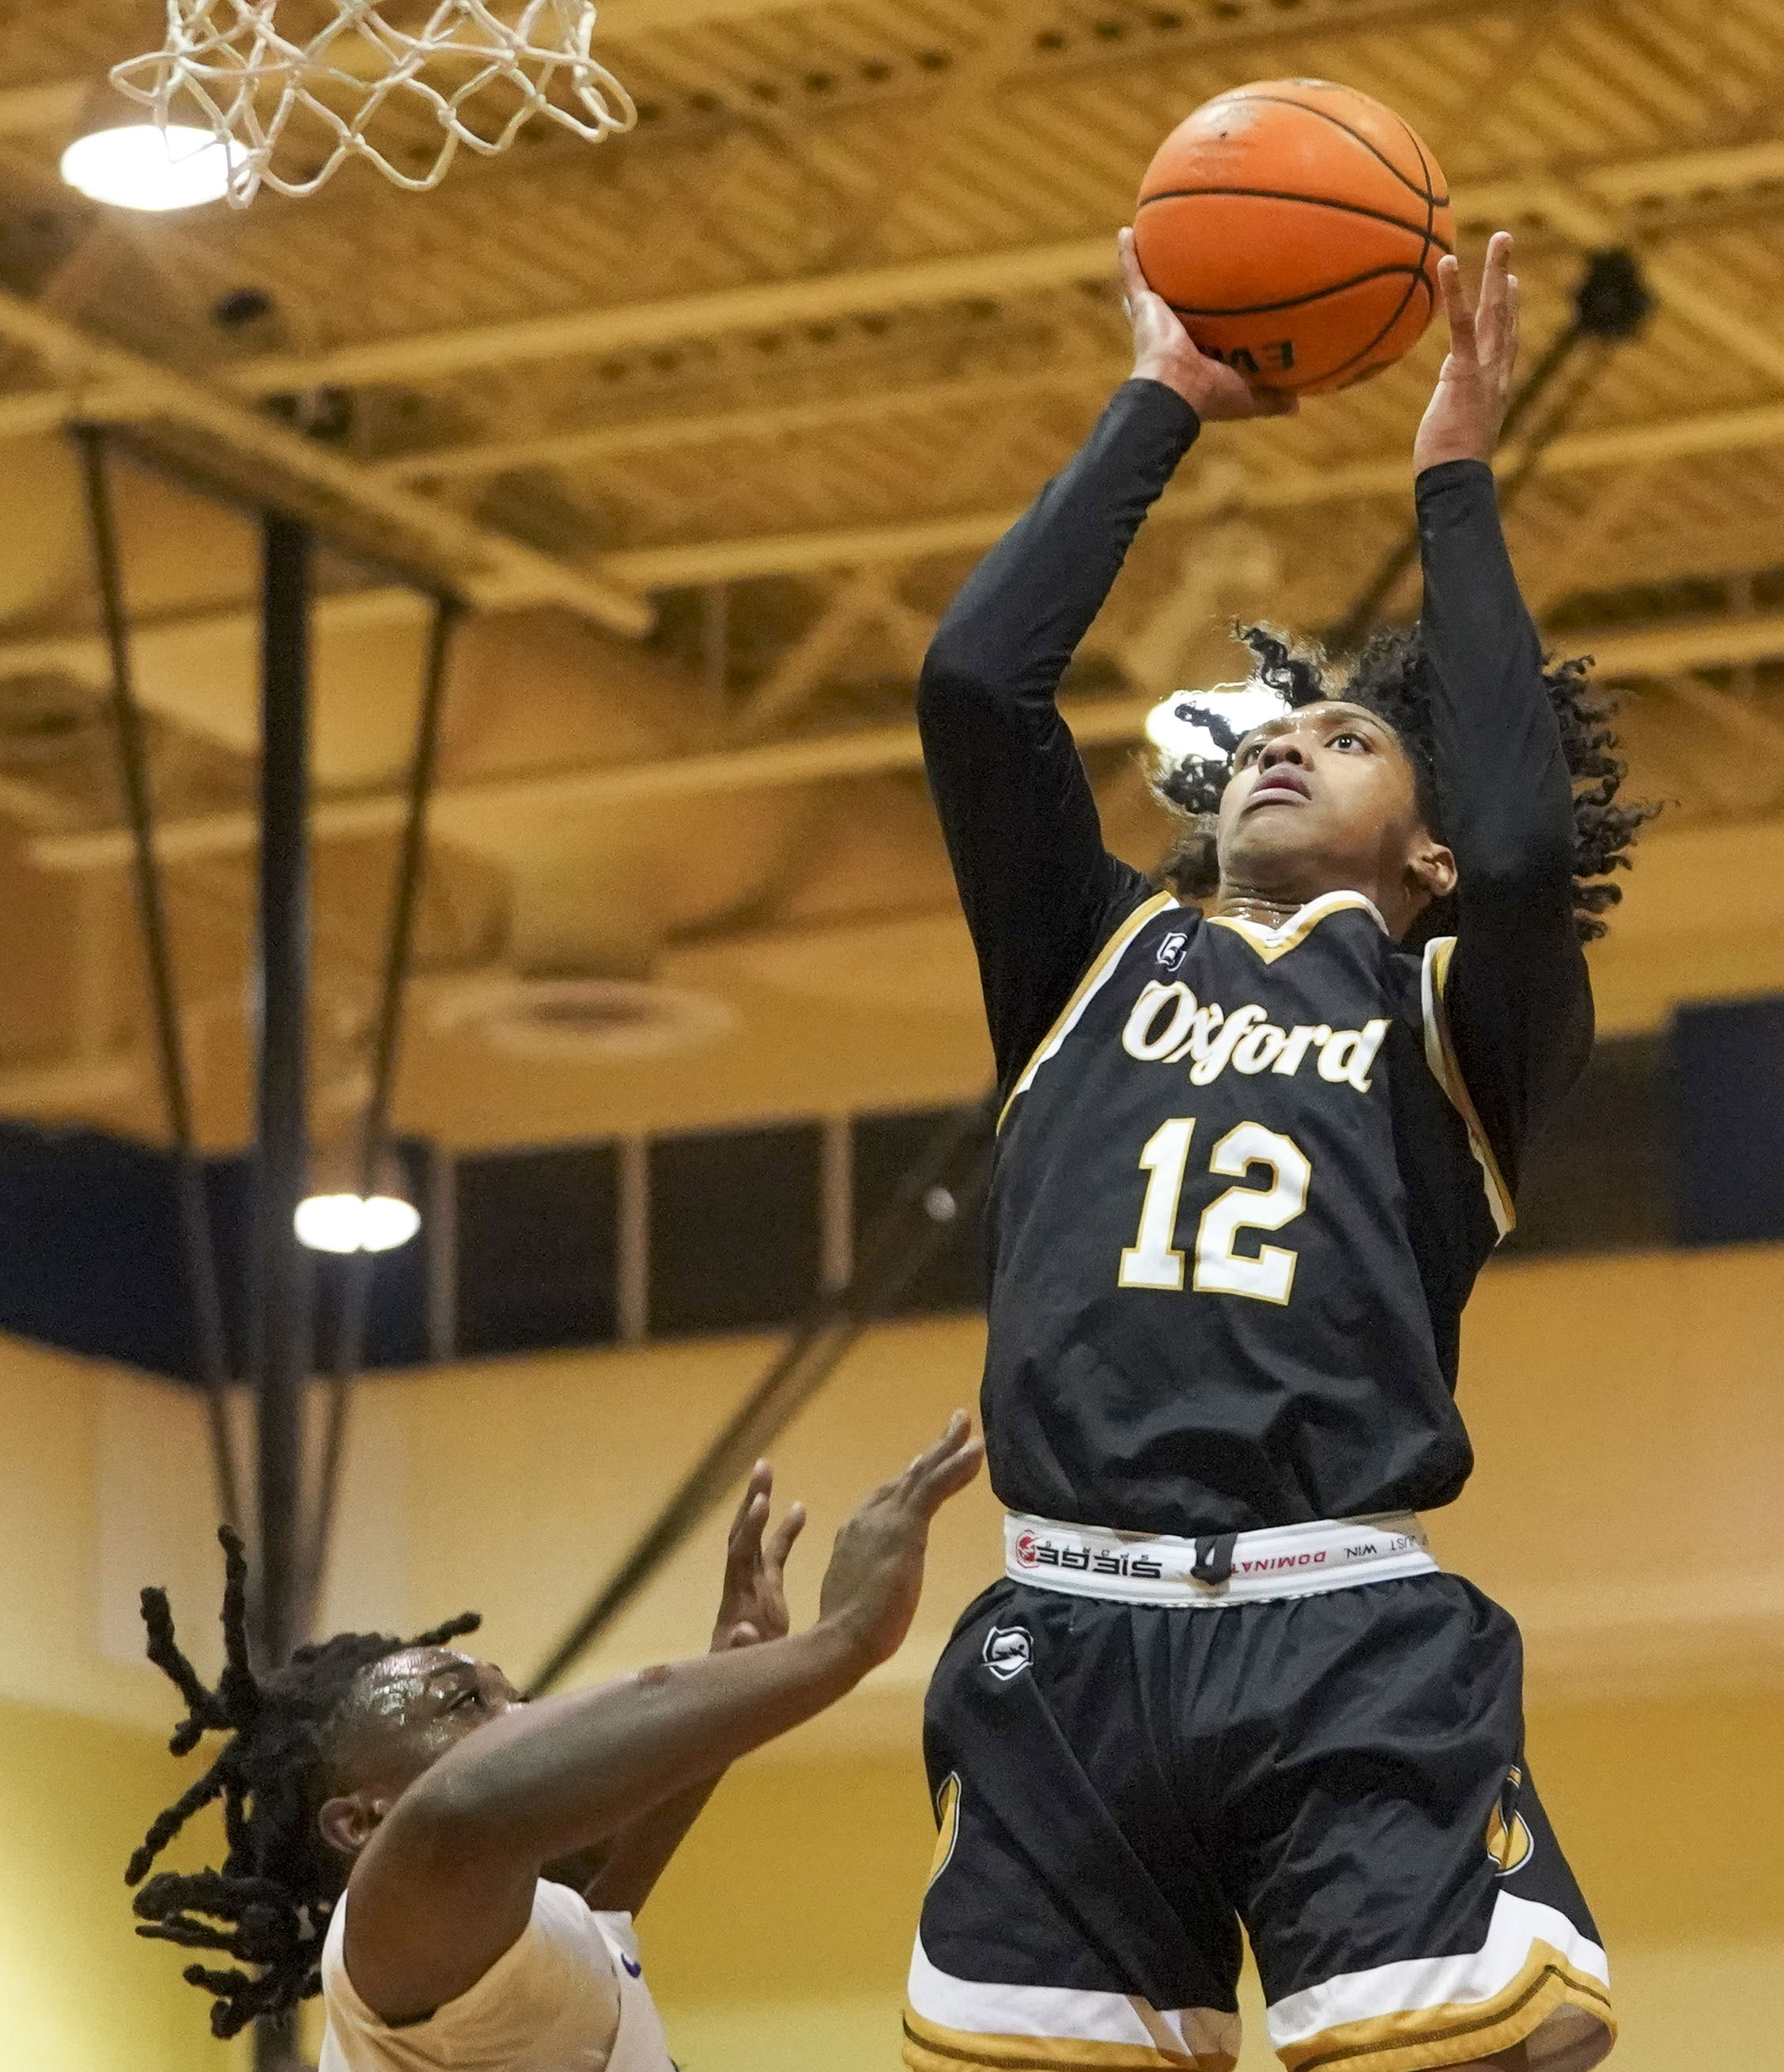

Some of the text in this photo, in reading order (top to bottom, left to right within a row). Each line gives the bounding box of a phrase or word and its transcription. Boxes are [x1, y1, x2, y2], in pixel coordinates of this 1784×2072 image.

[1195, 338, 1295, 374] EV
[1121, 980, 1393, 1094] Oxford
[1117, 1117, 1312, 1306] 12
[1035, 1545, 1162, 1579] SIEGE
[1230, 1551, 1327, 1575] DOMINAT
